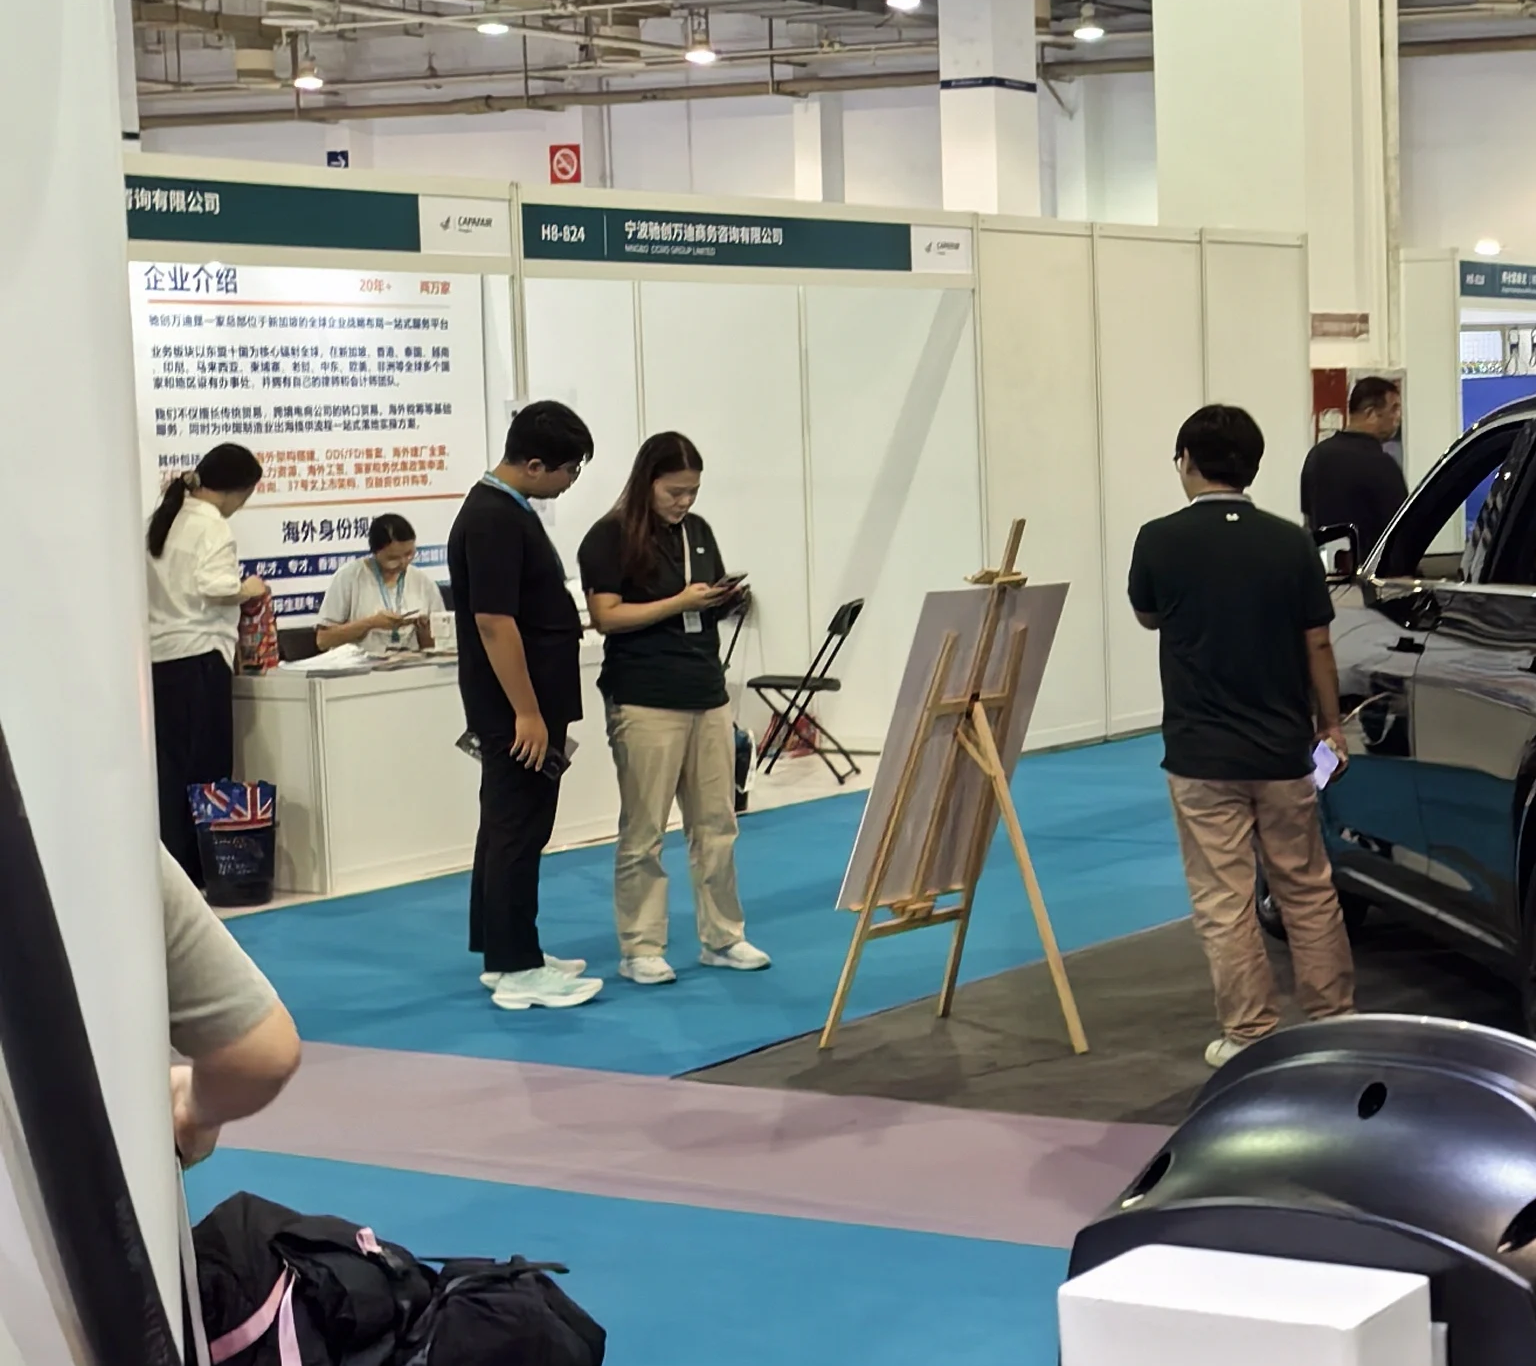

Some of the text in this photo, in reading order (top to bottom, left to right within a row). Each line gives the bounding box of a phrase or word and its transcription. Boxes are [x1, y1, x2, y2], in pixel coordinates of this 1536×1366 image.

[541, 224, 586, 243] H8-824
[624, 220, 783, 245] 宁波驰创万迪商务咨询有限公司
[143, 264, 238, 295] 企业介绍
[282, 516, 378, 544] 海外身份规
